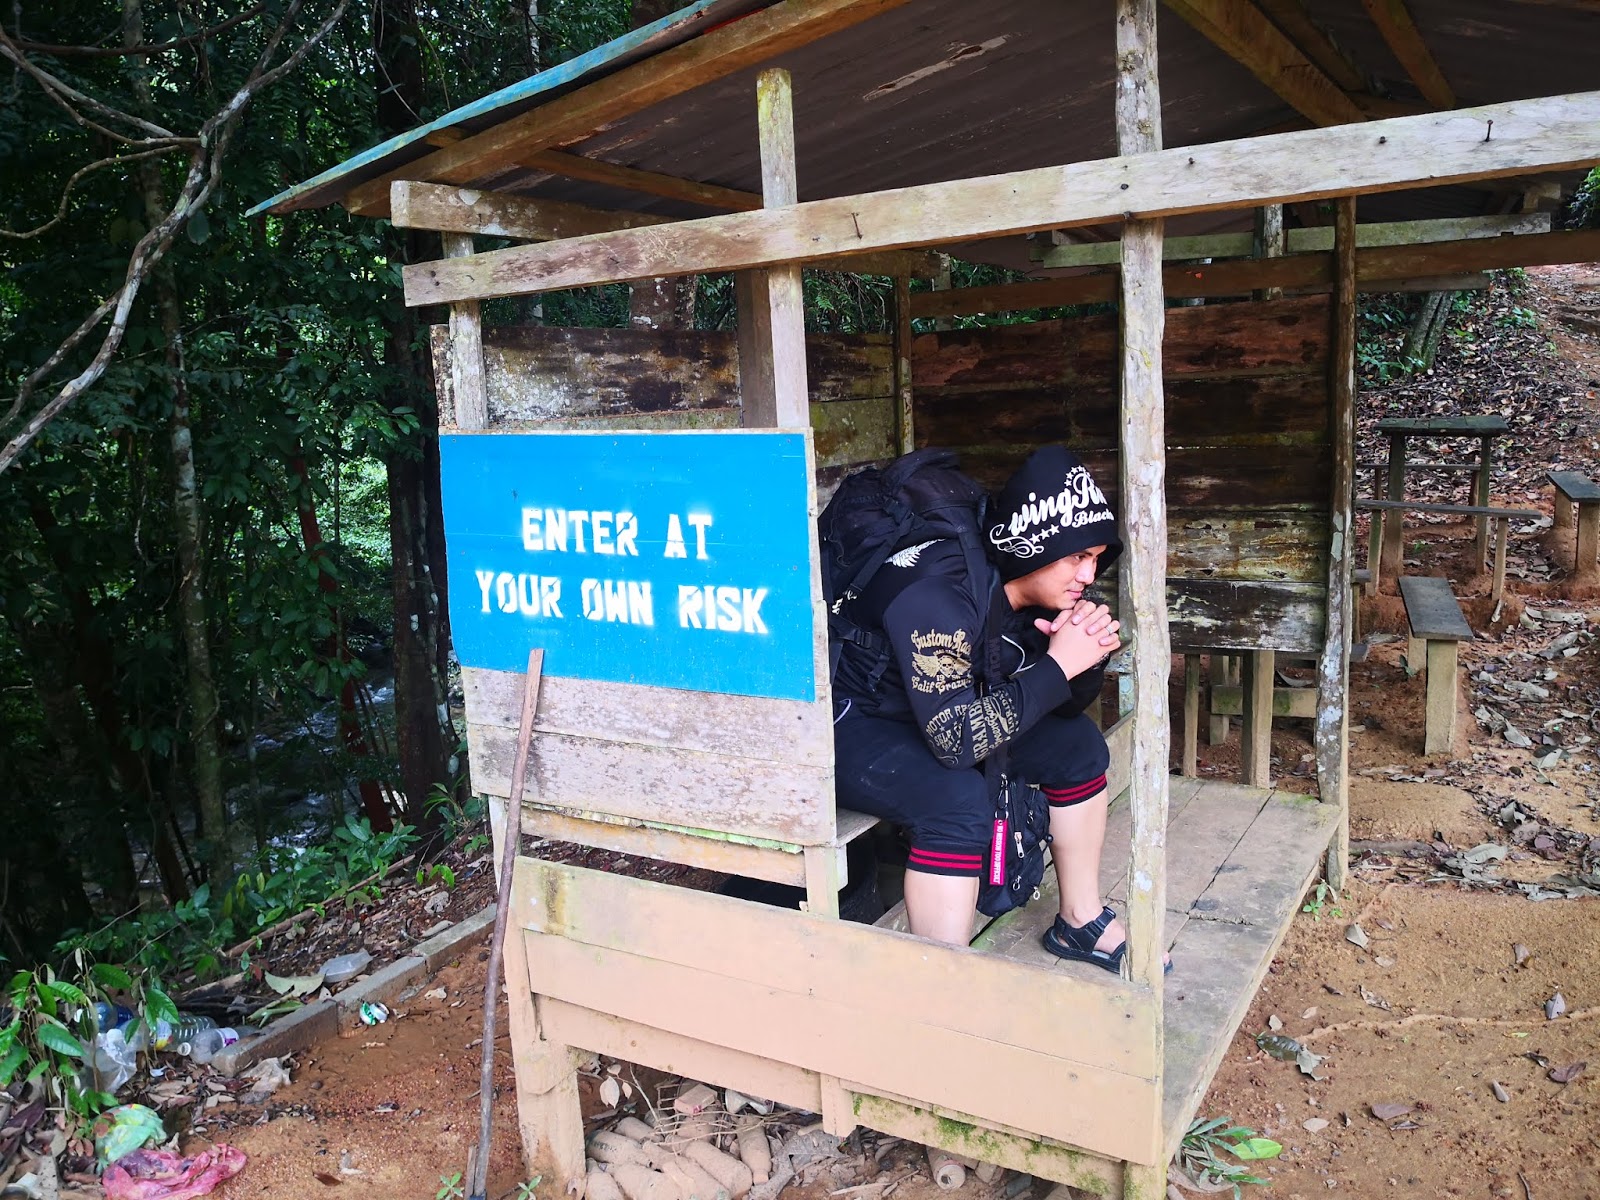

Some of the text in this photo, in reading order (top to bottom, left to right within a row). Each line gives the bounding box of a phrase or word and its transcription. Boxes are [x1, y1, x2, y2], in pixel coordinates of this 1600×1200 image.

[521, 508, 712, 560] ENTER AT
[475, 571, 768, 634] YOUR OWN RISK
[926, 708, 953, 738] MOTOR
